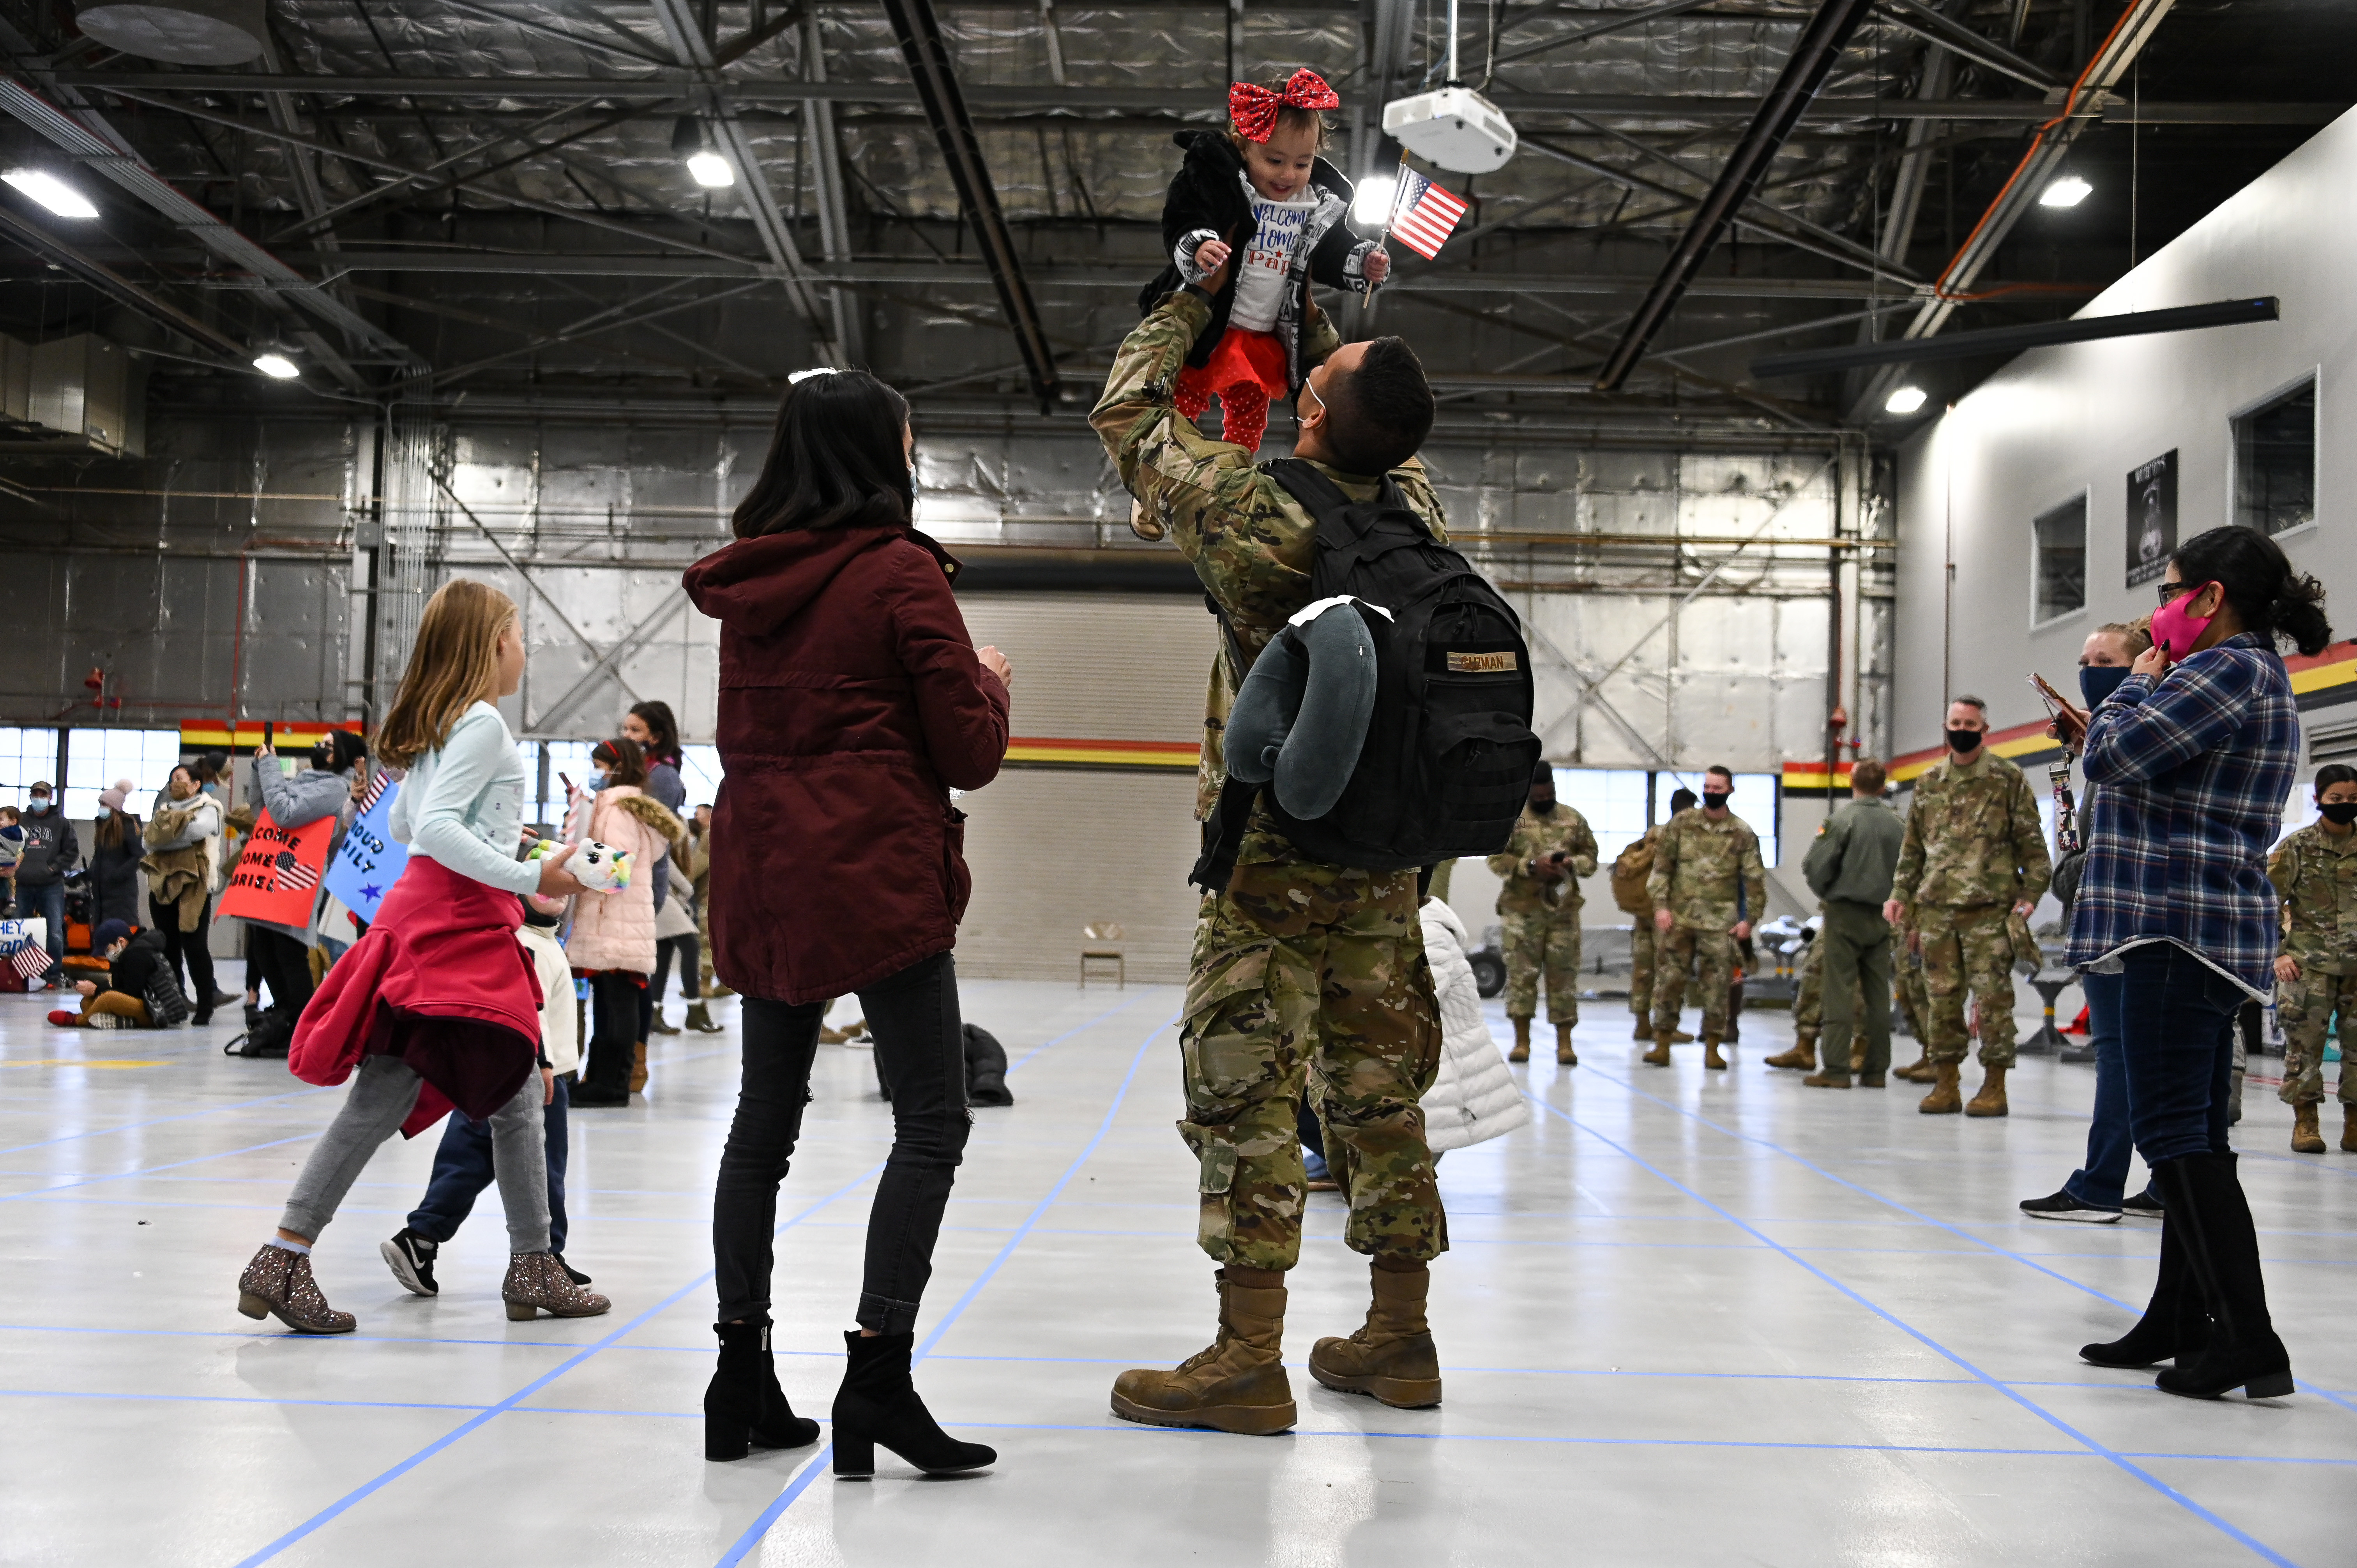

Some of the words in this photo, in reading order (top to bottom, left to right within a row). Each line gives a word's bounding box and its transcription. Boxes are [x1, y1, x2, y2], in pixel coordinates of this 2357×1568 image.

[1253, 203, 1306, 229] WELCOM
[1247, 250, 1291, 275] Pap
[1461, 656, 1504, 670] GUZMAN
[27, 825, 53, 842] SA
[250, 827, 302, 851] COME
[238, 852, 274, 867] OME
